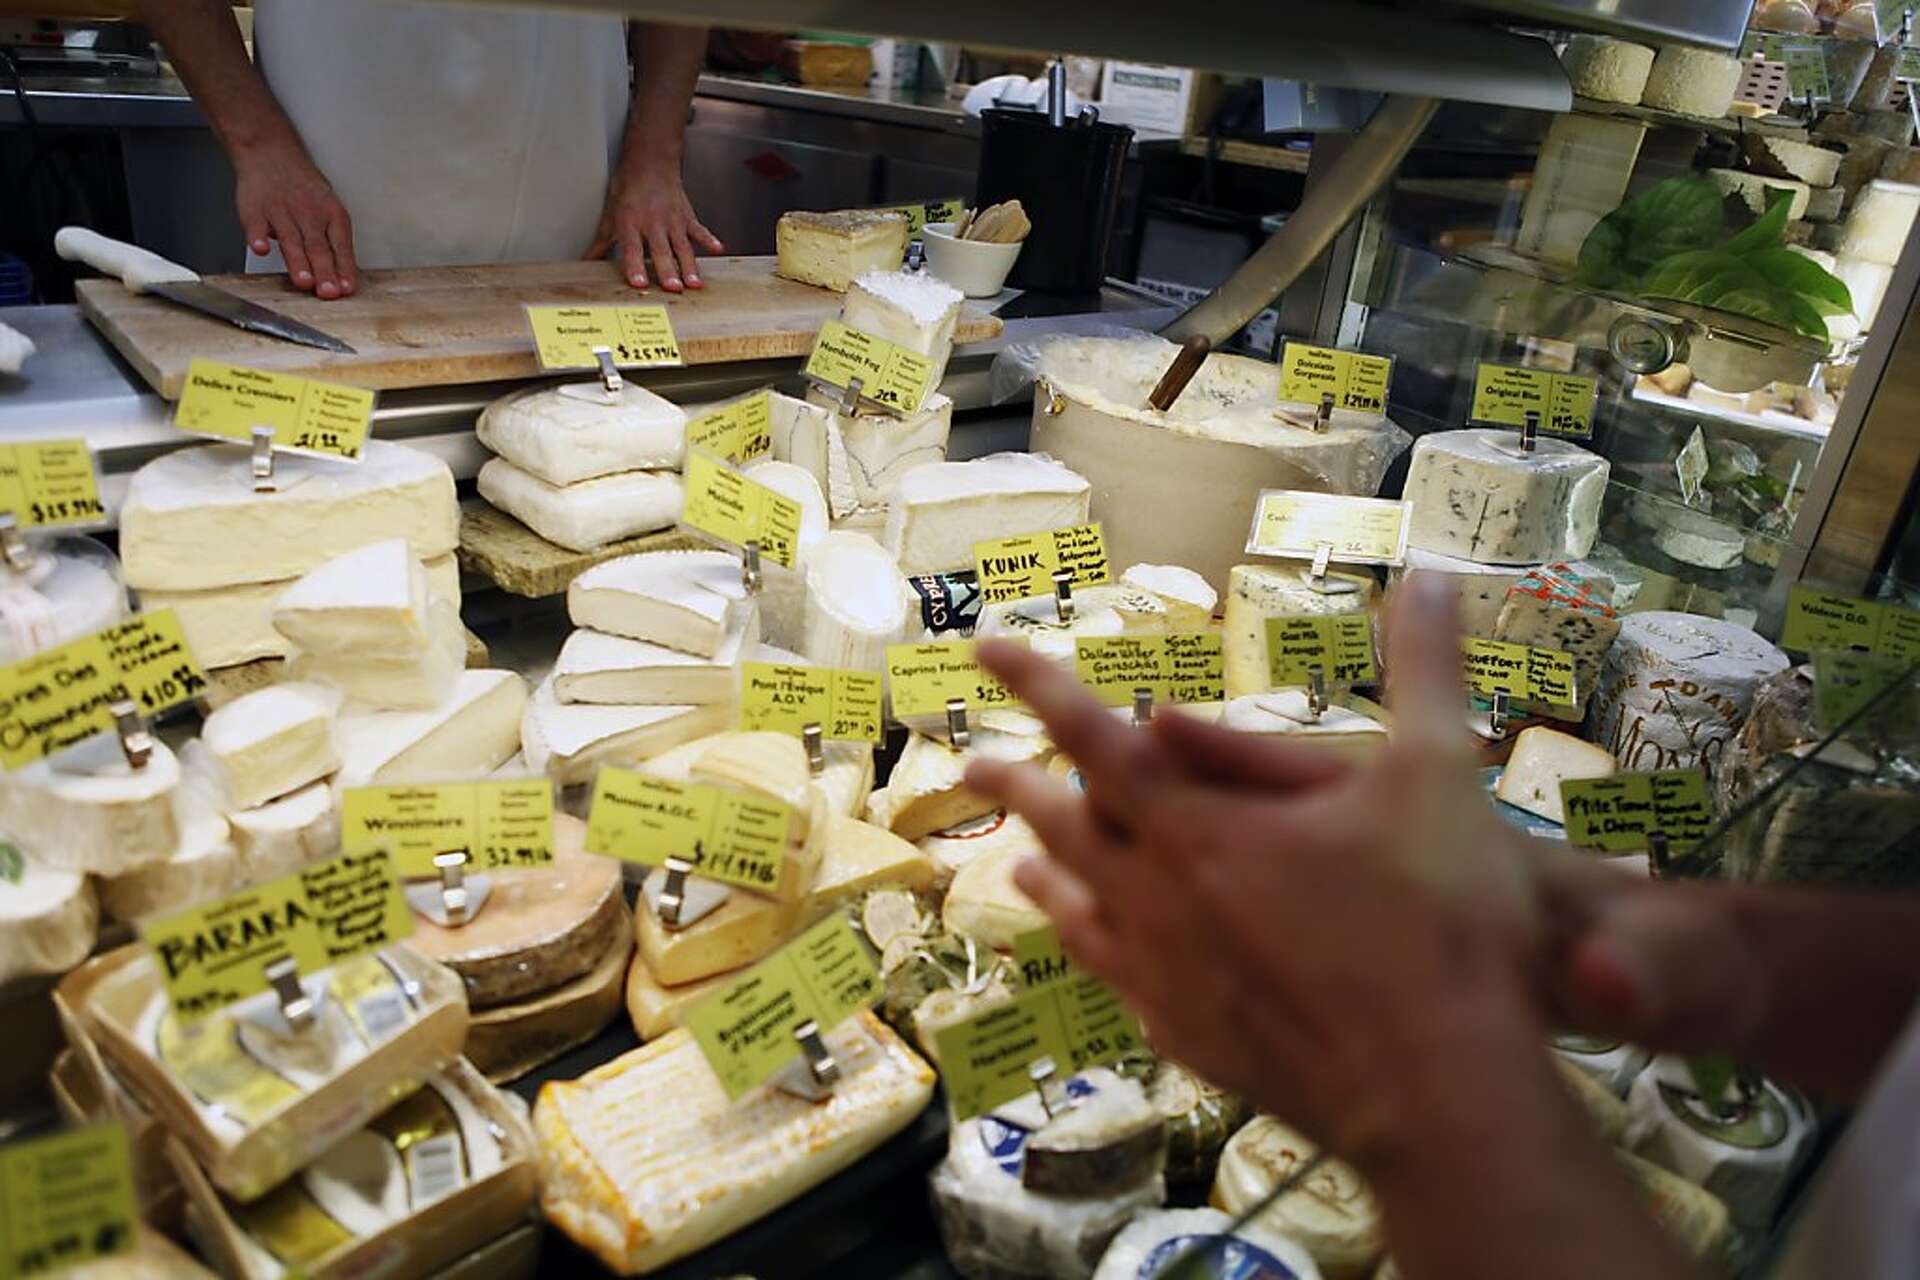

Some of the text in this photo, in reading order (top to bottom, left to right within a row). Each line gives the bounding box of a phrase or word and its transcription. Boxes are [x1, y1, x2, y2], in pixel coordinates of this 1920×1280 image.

[982, 552, 1046, 577] KUNIK
[891, 661, 978, 677] Caprino Fiorito
[157, 899, 312, 981] BARAKA
